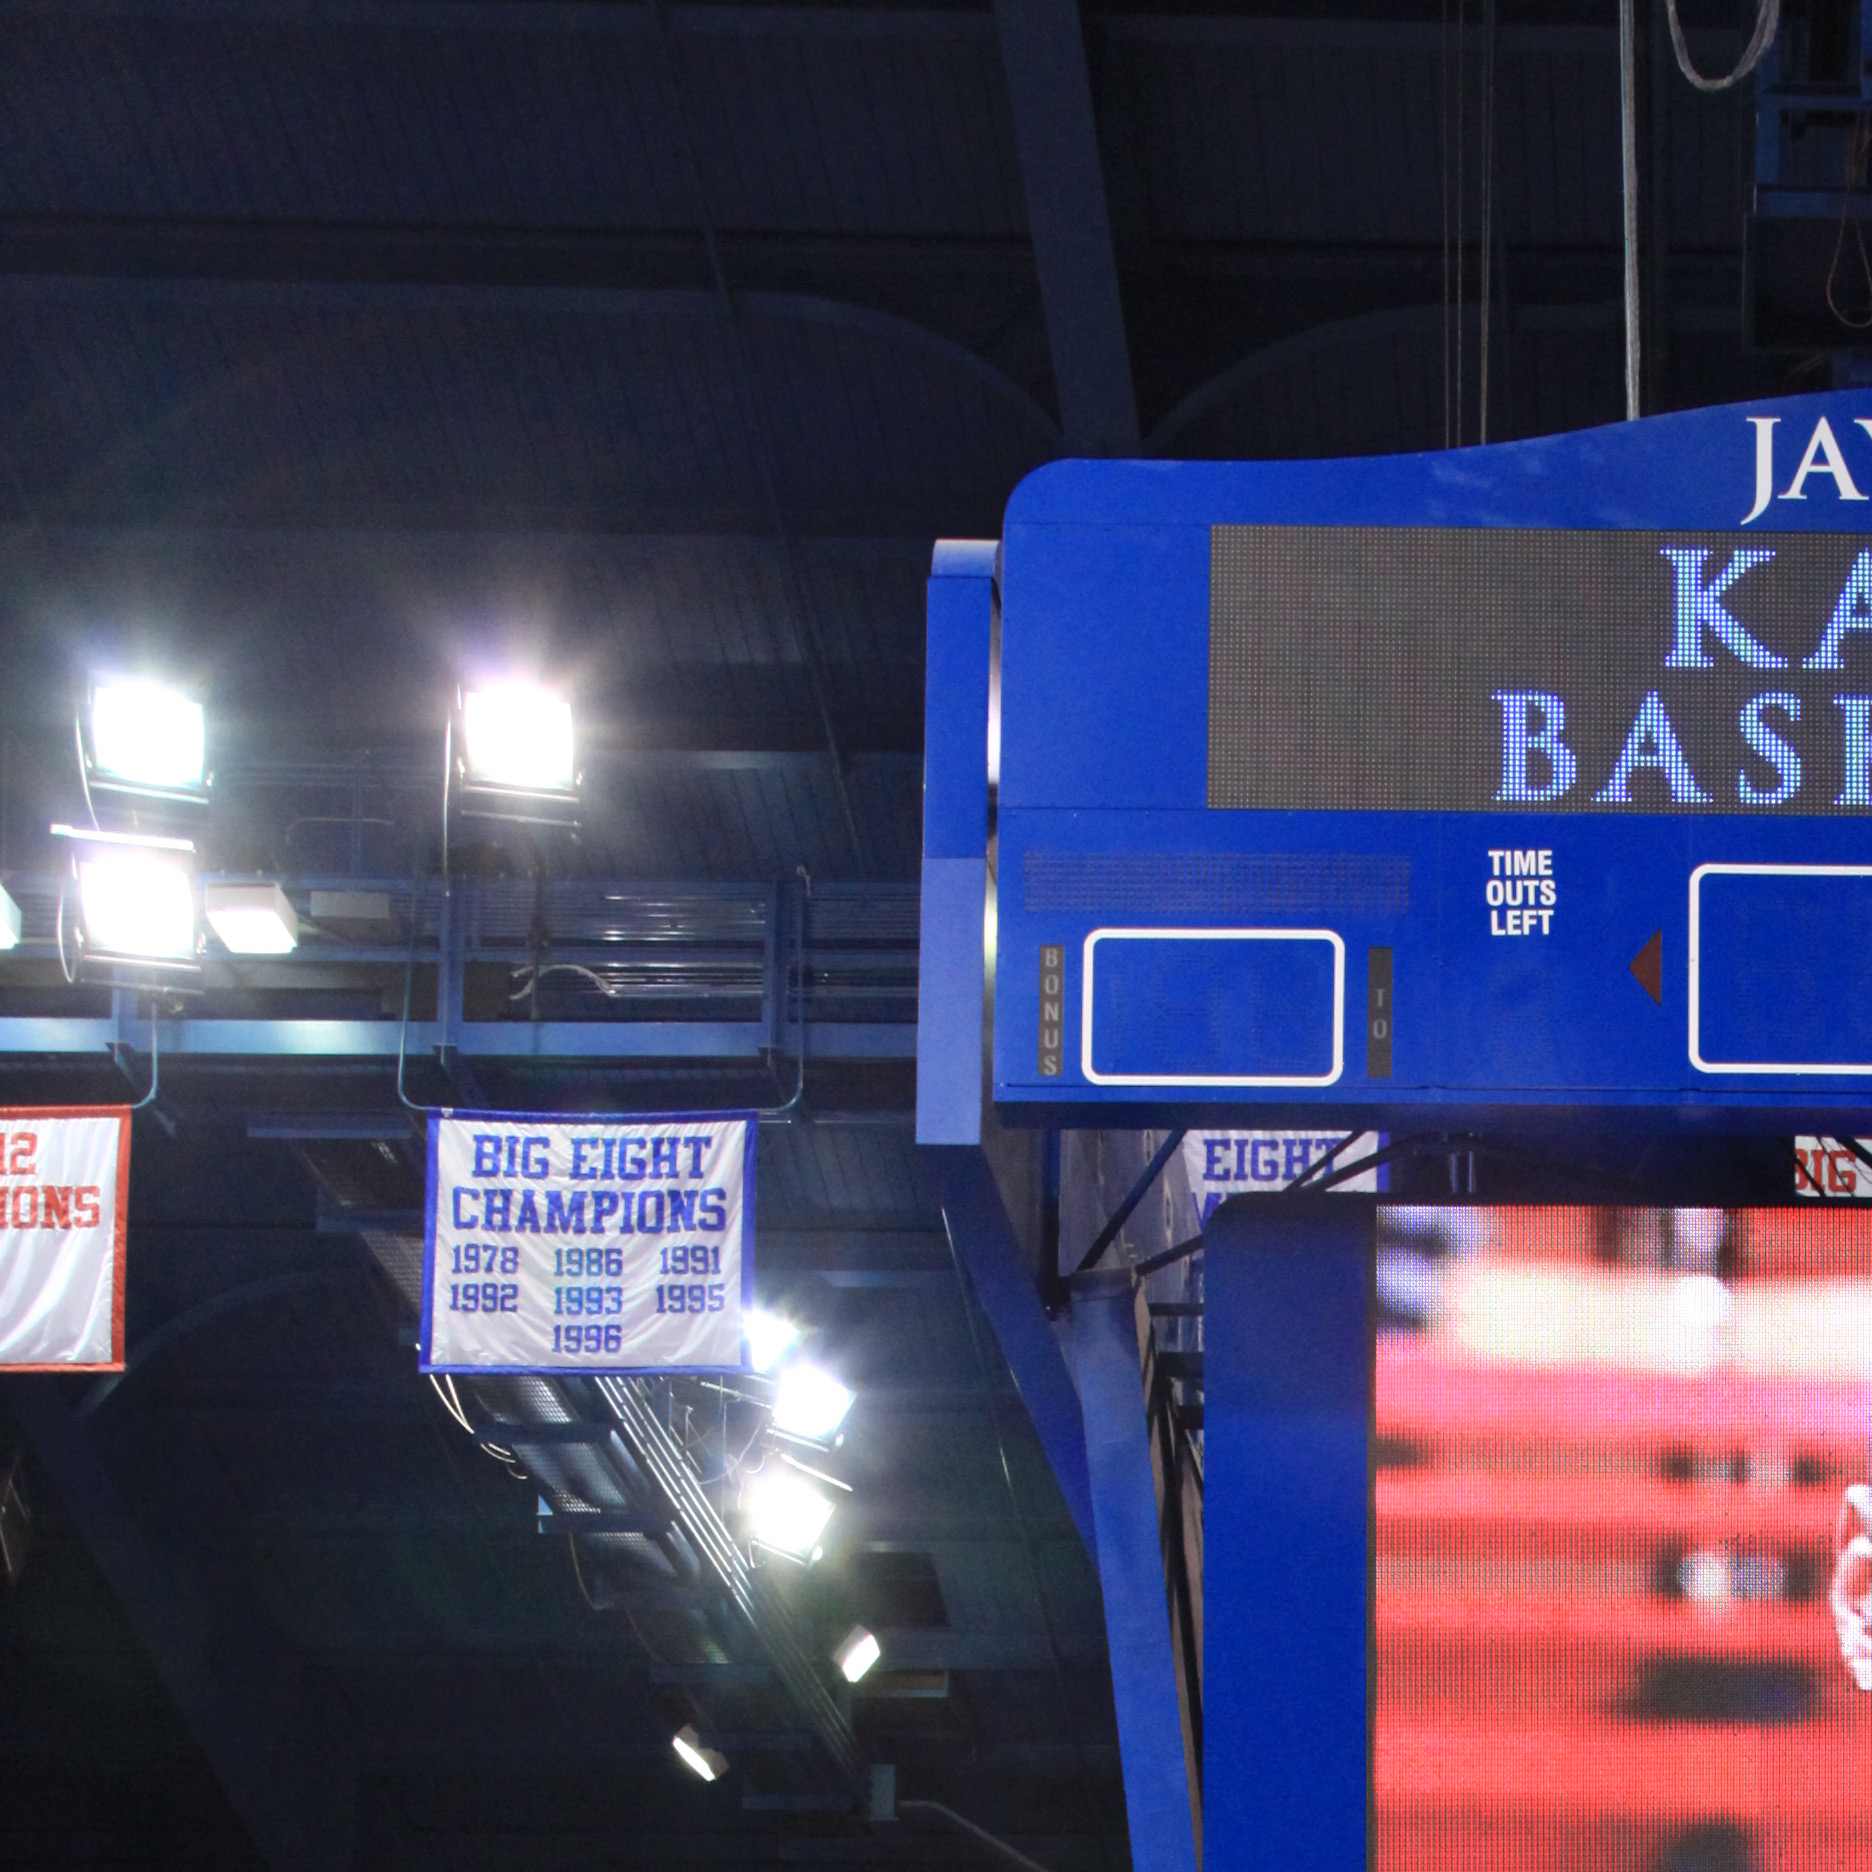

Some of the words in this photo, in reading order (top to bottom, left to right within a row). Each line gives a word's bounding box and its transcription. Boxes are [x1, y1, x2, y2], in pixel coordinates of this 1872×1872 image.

[1487, 850, 1554, 877] TIME
[1485, 878, 1557, 907] OUTS
[1489, 909, 1555, 937] LEFT
[1043, 948, 1060, 1076] BONUS
[1372, 986, 1388, 1040] TO
[473, 1133, 551, 1180] BIG
[571, 1135, 714, 1181] EIGHT
[450, 1187, 728, 1235] CHAMPIONS
[450, 1244, 520, 1275] 1978
[553, 1247, 625, 1278] 1986
[659, 1245, 722, 1276] 1991
[448, 1283, 519, 1314] 1992
[553, 1286, 624, 1316] 1993
[655, 1284, 725, 1315] 1995
[551, 1325, 622, 1355] 1996
